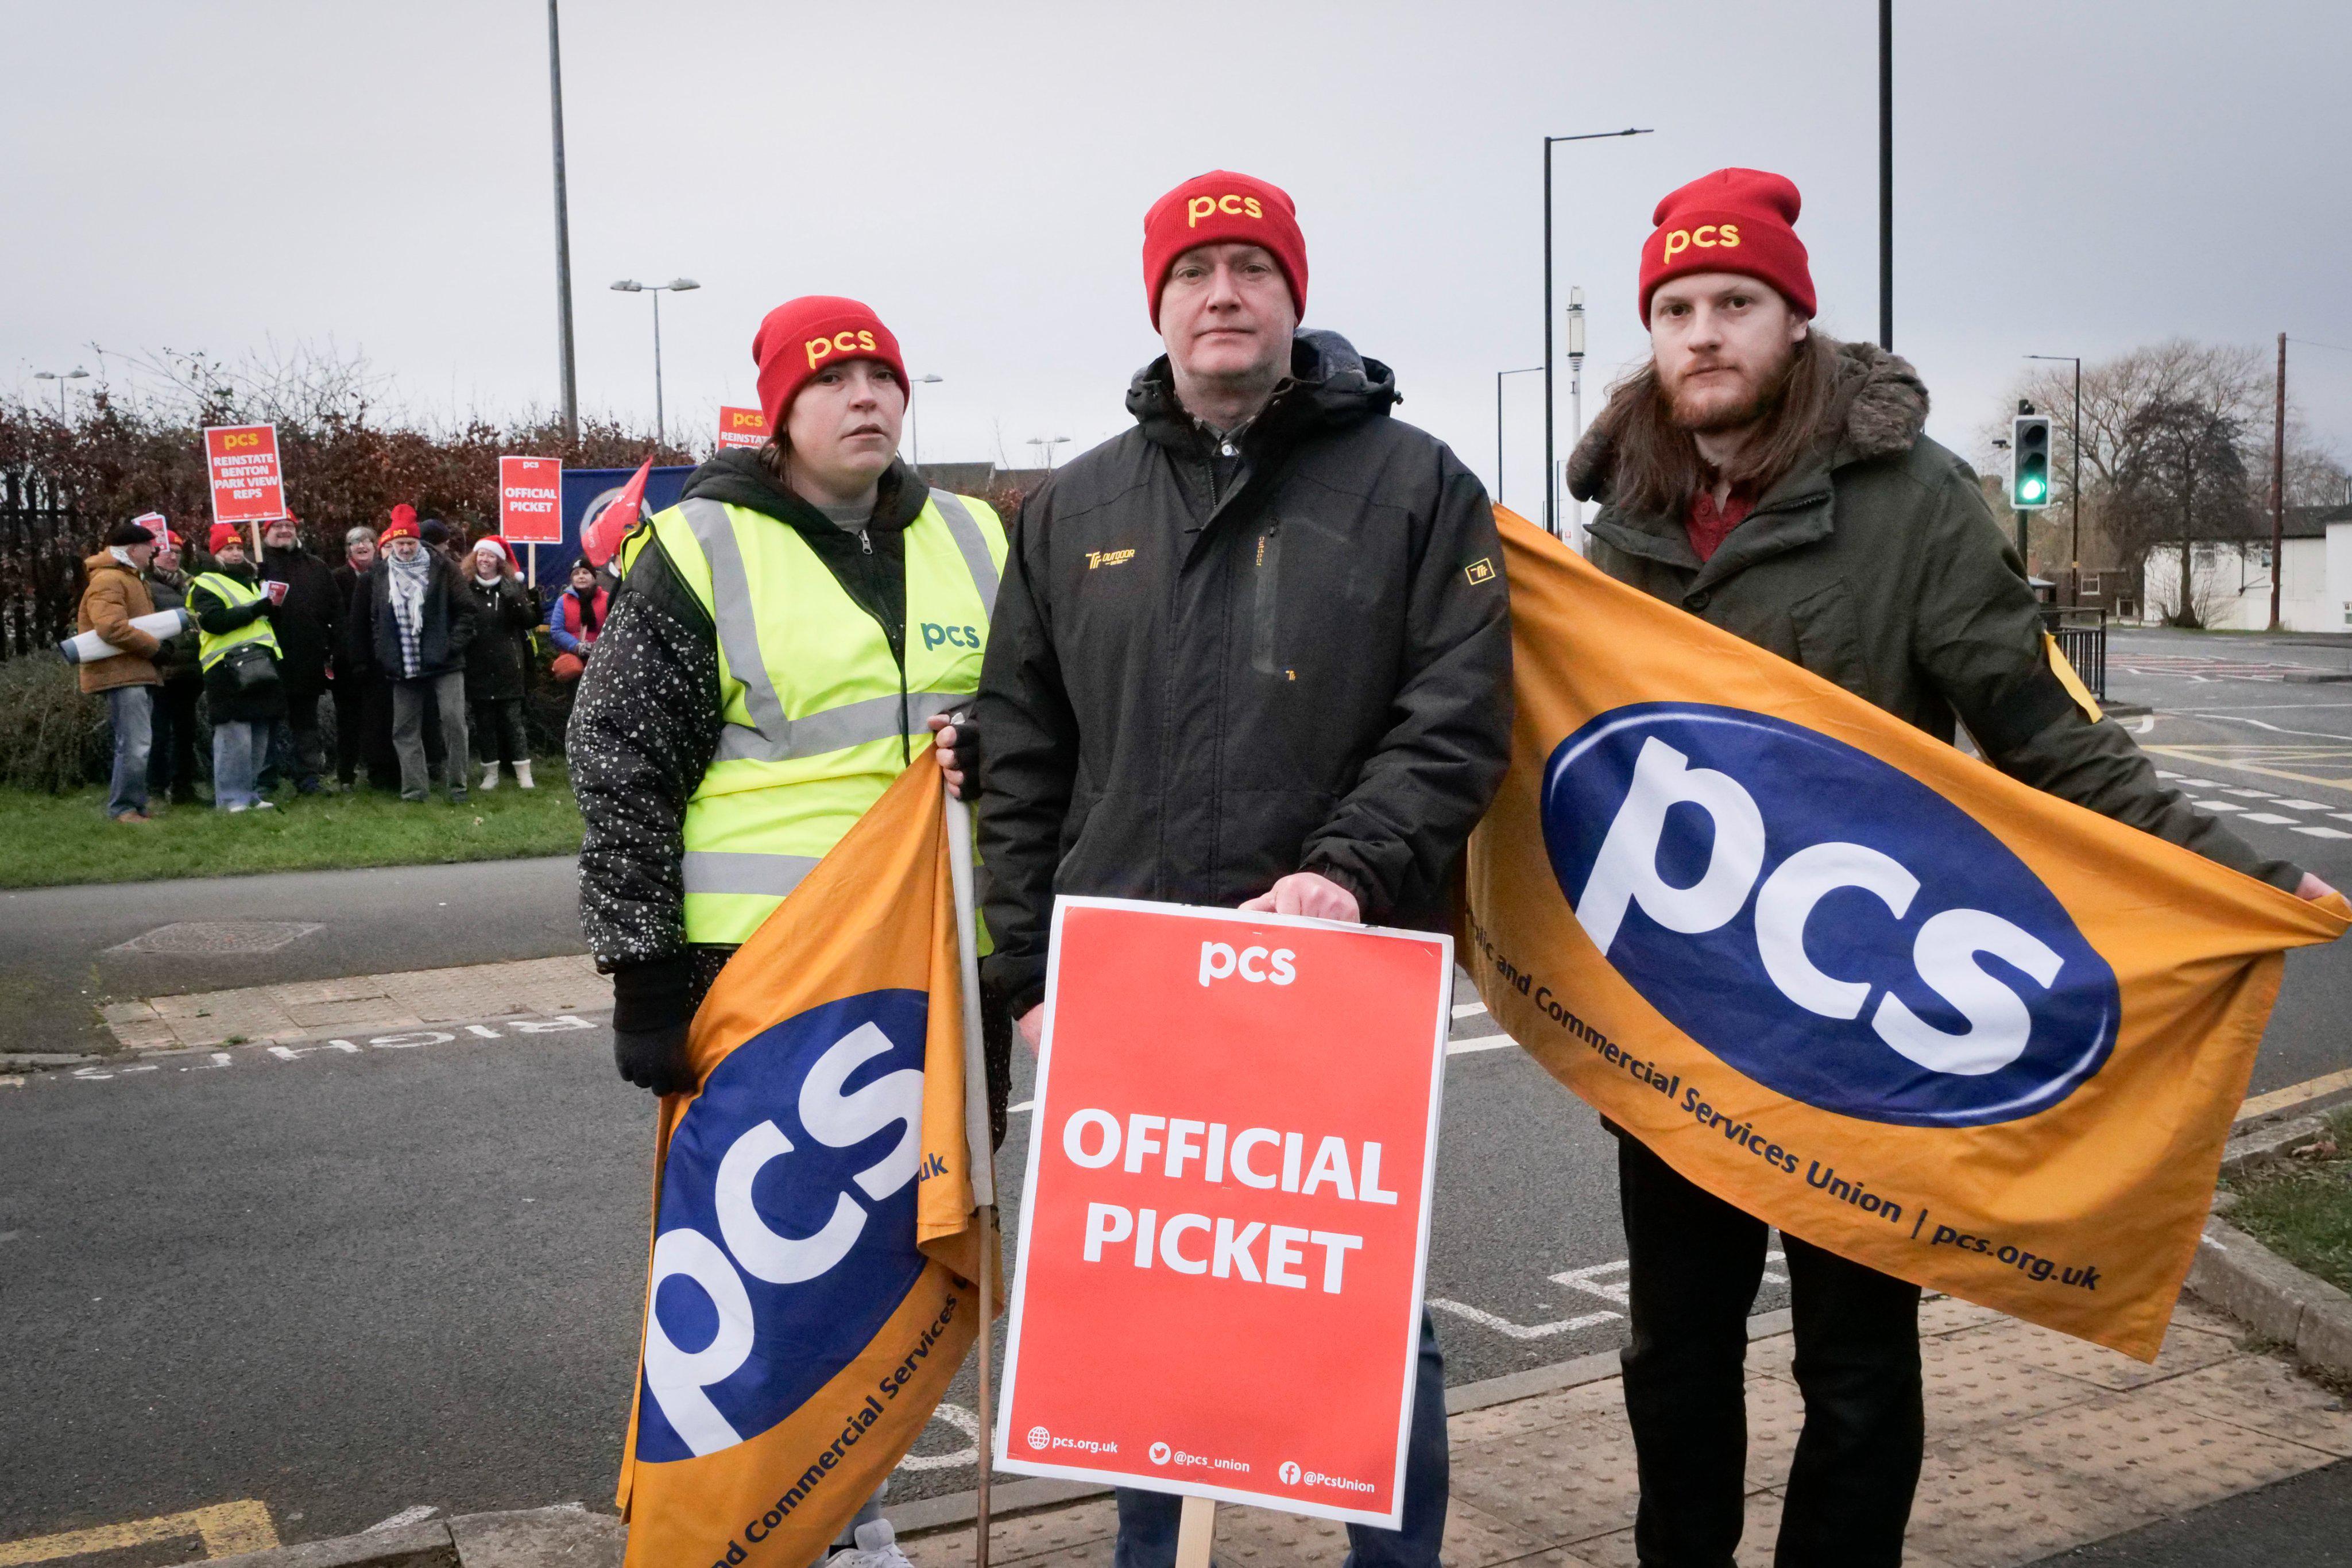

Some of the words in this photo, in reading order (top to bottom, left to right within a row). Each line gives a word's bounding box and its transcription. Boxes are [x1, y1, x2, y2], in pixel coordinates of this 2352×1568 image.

[1188, 195, 1263, 228] pcs
[1664, 224, 1740, 265] pcs
[805, 330, 876, 370] pcs
[733, 412, 763, 427] pcs
[224, 433, 258, 451] pcs
[214, 454, 274, 466] REINSTATE
[221, 465, 269, 478] BENTON
[523, 461, 539, 469] pcs
[214, 478, 245, 489] PARK
[247, 475, 278, 487] VIEW
[505, 487, 557, 499] OFFICIAL
[233, 488, 263, 500] REPS
[510, 501, 553, 513] PICKET
[920, 623, 980, 651] pcs
[1575, 735, 2065, 1075] pcs
[1198, 940, 1297, 988] pcs
[1496, 954, 1532, 996] and
[1535, 986, 1680, 1099] Commercial
[1681, 1087, 1800, 1174] Services
[1806, 1160, 1902, 1223] Union
[1931, 1224, 2100, 1291] pcs.org.uk
[1062, 1108, 1398, 1206] OFFICIAL
[644, 1021, 924, 1458] pcs
[1082, 1202, 1363, 1295] PICKET
[745, 1395, 884, 1543] Commercial
[879, 1293, 957, 1400] Services
[1052, 1434, 1118, 1453] pcs.org.uk
[1173, 1450, 1250, 1473] @pcs_union
[1303, 1470, 1375, 1493] @PcsUnion
